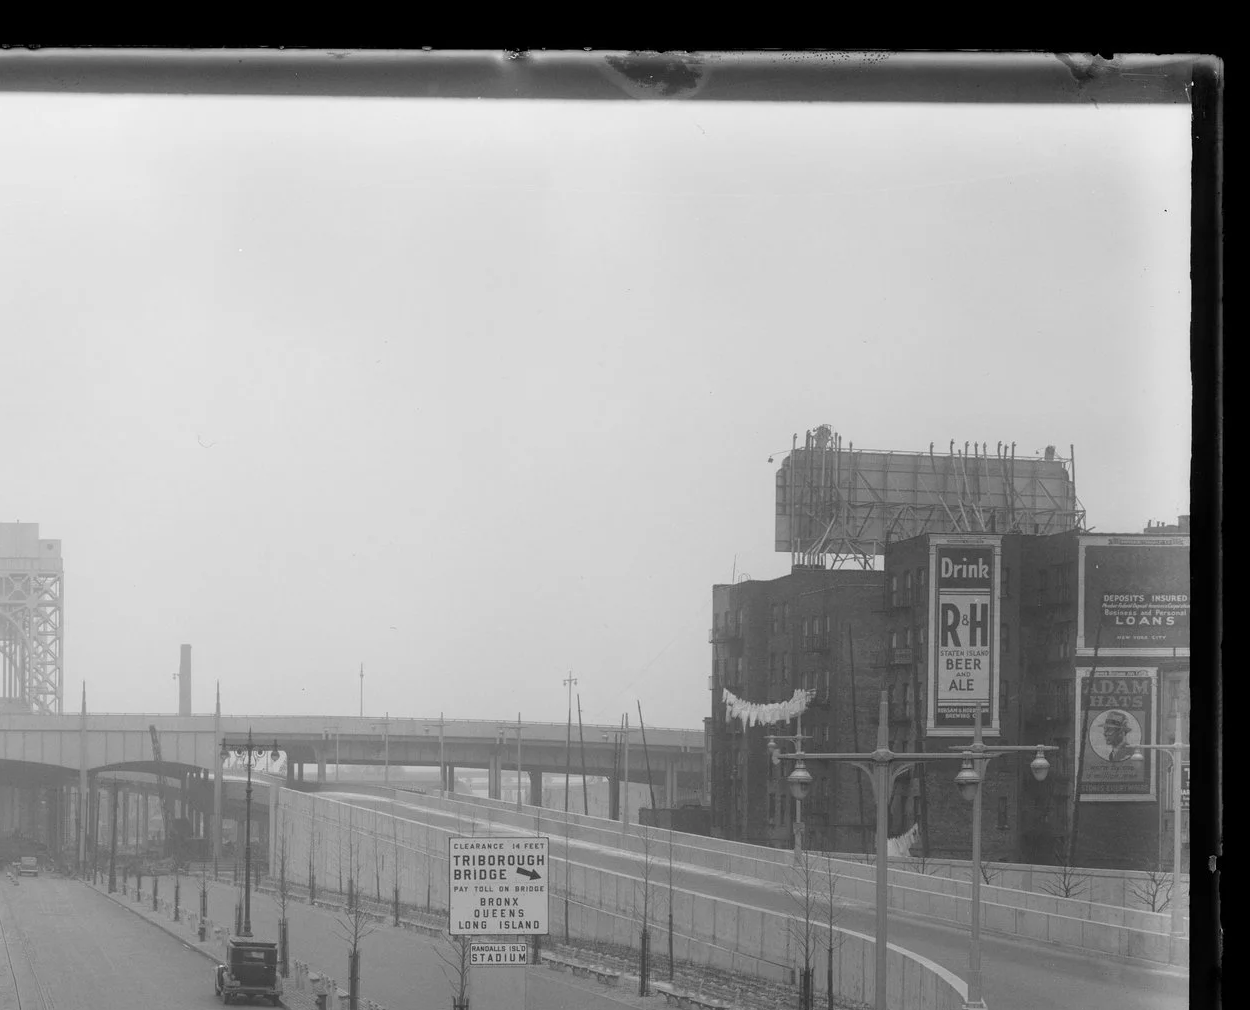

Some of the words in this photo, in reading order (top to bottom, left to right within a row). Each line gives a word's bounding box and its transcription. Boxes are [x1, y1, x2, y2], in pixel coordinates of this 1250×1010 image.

[941, 557, 990, 579] Drink
[1103, 594, 1145, 602] DEPOSITS
[1151, 594, 1188, 602] INSURED
[1115, 616, 1175, 625] LOANS
[946, 658, 982, 670] BEER
[949, 679, 975, 691] ALE
[1090, 695, 1143, 707] HATS
[453, 855, 545, 866] TRIBOROUGH
[453, 869, 507, 880] BRIDGE
[453, 885, 469, 893] PAY
[474, 885, 494, 893] TOLL
[480, 897, 519, 906] BRONX
[474, 909, 525, 918] QUEENS
[458, 921, 487, 929] LONG
[499, 920, 540, 929] ISLAND
[471, 953, 526, 962] STADIUM
